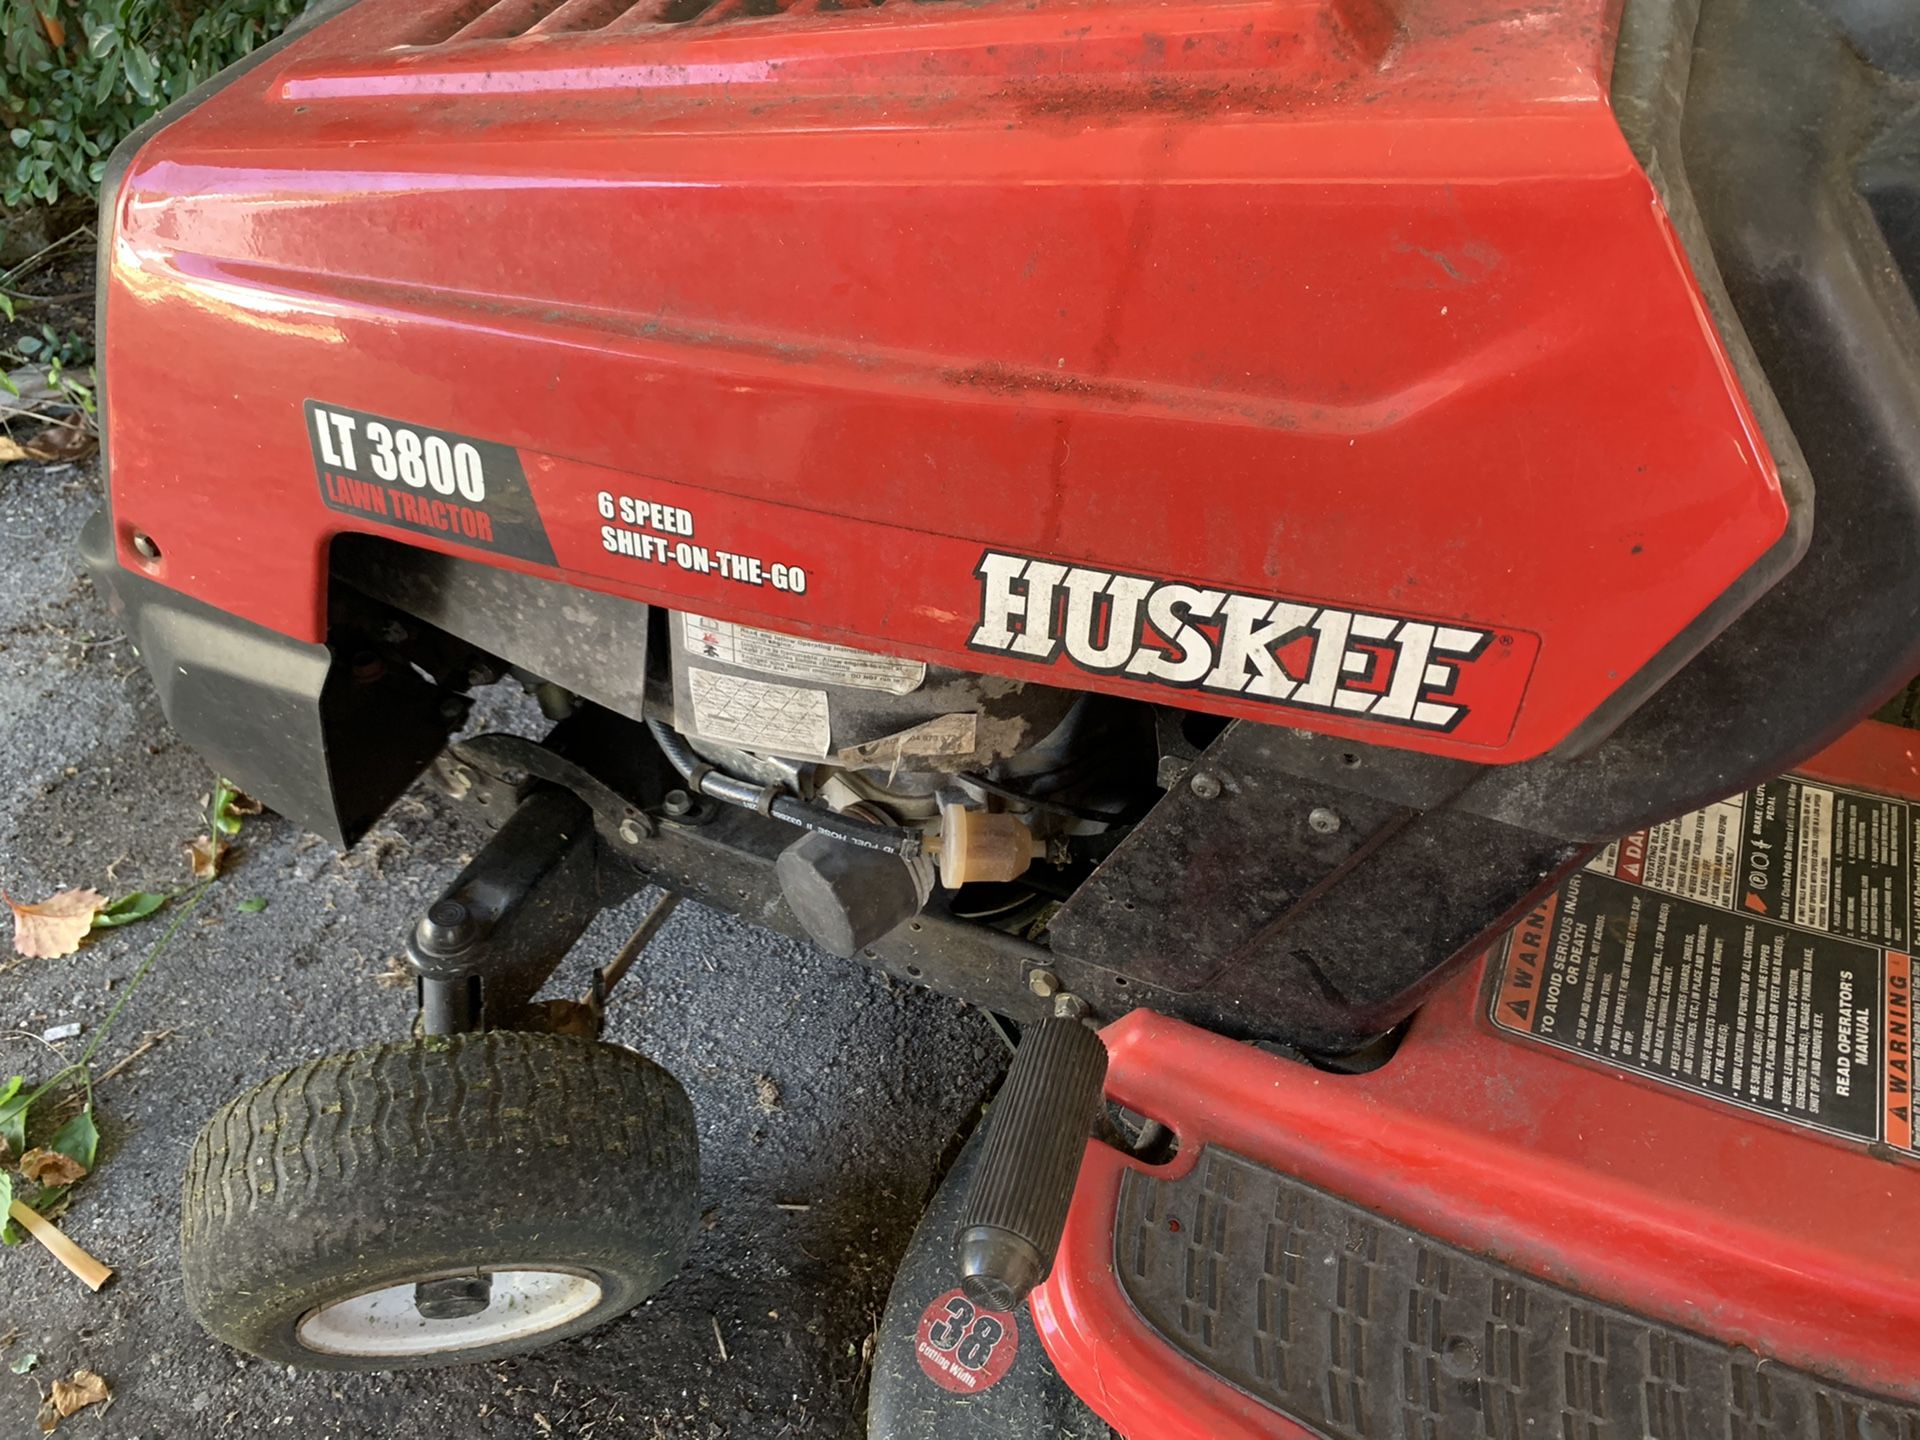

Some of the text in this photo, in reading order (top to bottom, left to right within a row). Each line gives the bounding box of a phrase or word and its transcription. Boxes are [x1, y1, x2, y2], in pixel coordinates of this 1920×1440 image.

[314, 408, 486, 504] LT 3800
[325, 472, 493, 543] LAWN TRACTOR
[598, 491, 694, 538] 6 SPEED
[601, 526, 807, 594] SHIFT-ON-THE-GO
[968, 549, 1495, 734] HUSKEE
[1755, 783, 1766, 806] CLUTC
[1695, 814, 1704, 827] EVEN
[1766, 797, 1776, 821] PEDAL
[817, 827, 847, 841] HOSE
[1717, 813, 1727, 833] BEFORE
[1753, 810, 1763, 835] BRAKE
[852, 837, 879, 849] FUEL
[1658, 825, 1670, 854] INJURY
[1692, 829, 1703, 855] CHILDREN
[1644, 825, 1660, 882] ROTATING BLAD
[1690, 855, 1700, 874] CARRY
[1714, 854, 1723, 866] AND
[1654, 854, 1666, 888] SERIOUS
[1666, 866, 1675, 878] NOT
[1782, 860, 1792, 877] Pedal
[1665, 878, 1674, 887] DO
[1688, 874, 1697, 893] NEVER
[1710, 884, 1720, 900] LOOK
[1631, 896, 1641, 911] SLIP
[1628, 911, 1639, 932] COULD
[1657, 903, 1669, 932] BLADE(S)
[1553, 917, 1573, 970] SERIOUS
[1591, 940, 1601, 954] NOT
[1624, 940, 1635, 962] WHERE
[1655, 932, 1665, 949] STOP
[1566, 923, 1587, 984] OR DEATH
[1695, 955, 1704, 969] AND
[1621, 963, 1631, 979] UNIT
[1692, 969, 1703, 992] PLACE
[1711, 966, 1721, 976] BE
[1545, 973, 1562, 1013] AVOID
[1582, 981, 1594, 1002] DOWN
[1619, 979, 1629, 992] THE
[1648, 975, 1659, 996] GOING
[1691, 992, 1700, 1000] IN
[1709, 976, 1720, 999] COULD
[1801, 972, 1812, 1001] PARKING
[1580, 1003, 1590, 1018] AND
[1596, 996, 1608, 1024] SUDDEN
[1614, 993, 1627, 1024] OPERATE
[1645, 996, 1657, 1019] STOPS
[1652, 966, 1673, 1065] AND BACK DOWNHILL SLOWLY.
[1675, 994, 1687, 1023] DEVICES
[1689, 1000, 1700, 1019] ETC.)
[1707, 998, 1717, 1016] THAT
[1732, 925, 1754, 1090] KNOW LOCATION AND FUNCTION OF ALL CONTROLS.
[1763, 936, 1784, 1100] BEFORE PLACING HANDS OR FEET NEAR BLADE(S).
[1800, 1002, 1810, 1030] ENGAGE
[1540, 1015, 1555, 1032] TO
[1578, 1018, 1587, 1029] UP
[1611, 1024, 1622, 1040] NOT
[1749, 944, 1770, 1096] BE SURE BLADE(S) AND ENGINE ARE STOPPED
[1785, 1001, 1797, 1044] OPERATOR'S
[1576, 1029, 1586, 1040] GO
[1593, 1024, 1604, 1045] AVOID
[1623, 1031, 1634, 1055] OR TIP.
[1641, 1019, 1653, 1052] MACHINE
[1672, 1023, 1684, 1051] SAFETY
[1684, 1021, 1697, 1058] SWITCHES,
[1704, 1017, 1716, 1049] OBJECTS
[1836, 971, 1852, 1096] READ OPERATOR'S
[1855, 1008, 1869, 1065] MANUAL
[1889, 975, 1906, 1093] WARNING
[1610, 1040, 1620, 1051] DO
[1640, 1052, 1649, 1061] IF
[1714, 1024, 1729, 1085] BY THE BLADE(S).
[1670, 1051, 1680, 1070] KEEP
[1683, 1059, 1693, 1075] AND
[1700, 1049, 1712, 1080] REMOVE
[1784, 1045, 1794, 1075] LEAVING
[1809, 1013, 1823, 1114] SHUT OFF AND REMOVE KEY.
[1781, 1076, 1793, 1105] BEFORE
[1796, 1068, 1807, 1109] DISENGAGE
[928, 1296, 1004, 1371] 38
[918, 1342, 977, 1388] Cutting Width
